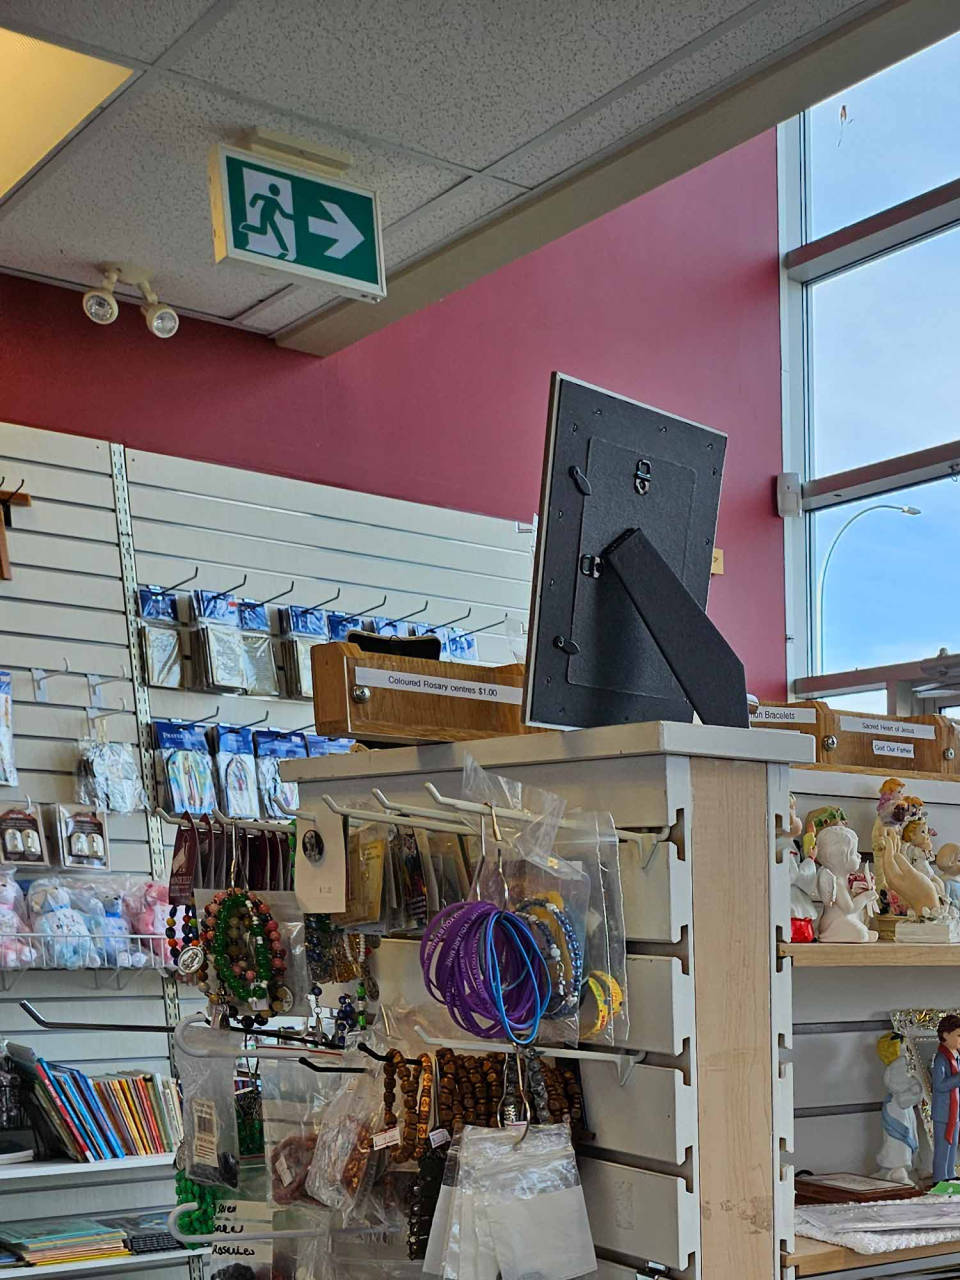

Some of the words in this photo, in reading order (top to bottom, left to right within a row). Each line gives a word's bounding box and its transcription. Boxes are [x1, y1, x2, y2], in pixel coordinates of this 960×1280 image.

[388, 675, 421, 688] Coloured
[423, 680, 449, 692] Rosary
[450, 685, 476, 695] centres
[478, 687, 498, 698] $1.00
[764, 710, 796, 720] Bracelets
[861, 722, 879, 731] Sacred
[880, 724, 894, 733] Heart
[900, 726, 915, 735] Jesus
[873, 744, 886, 752] God
[886, 745, 896, 753] Our
[896, 746, 912, 756] Father
